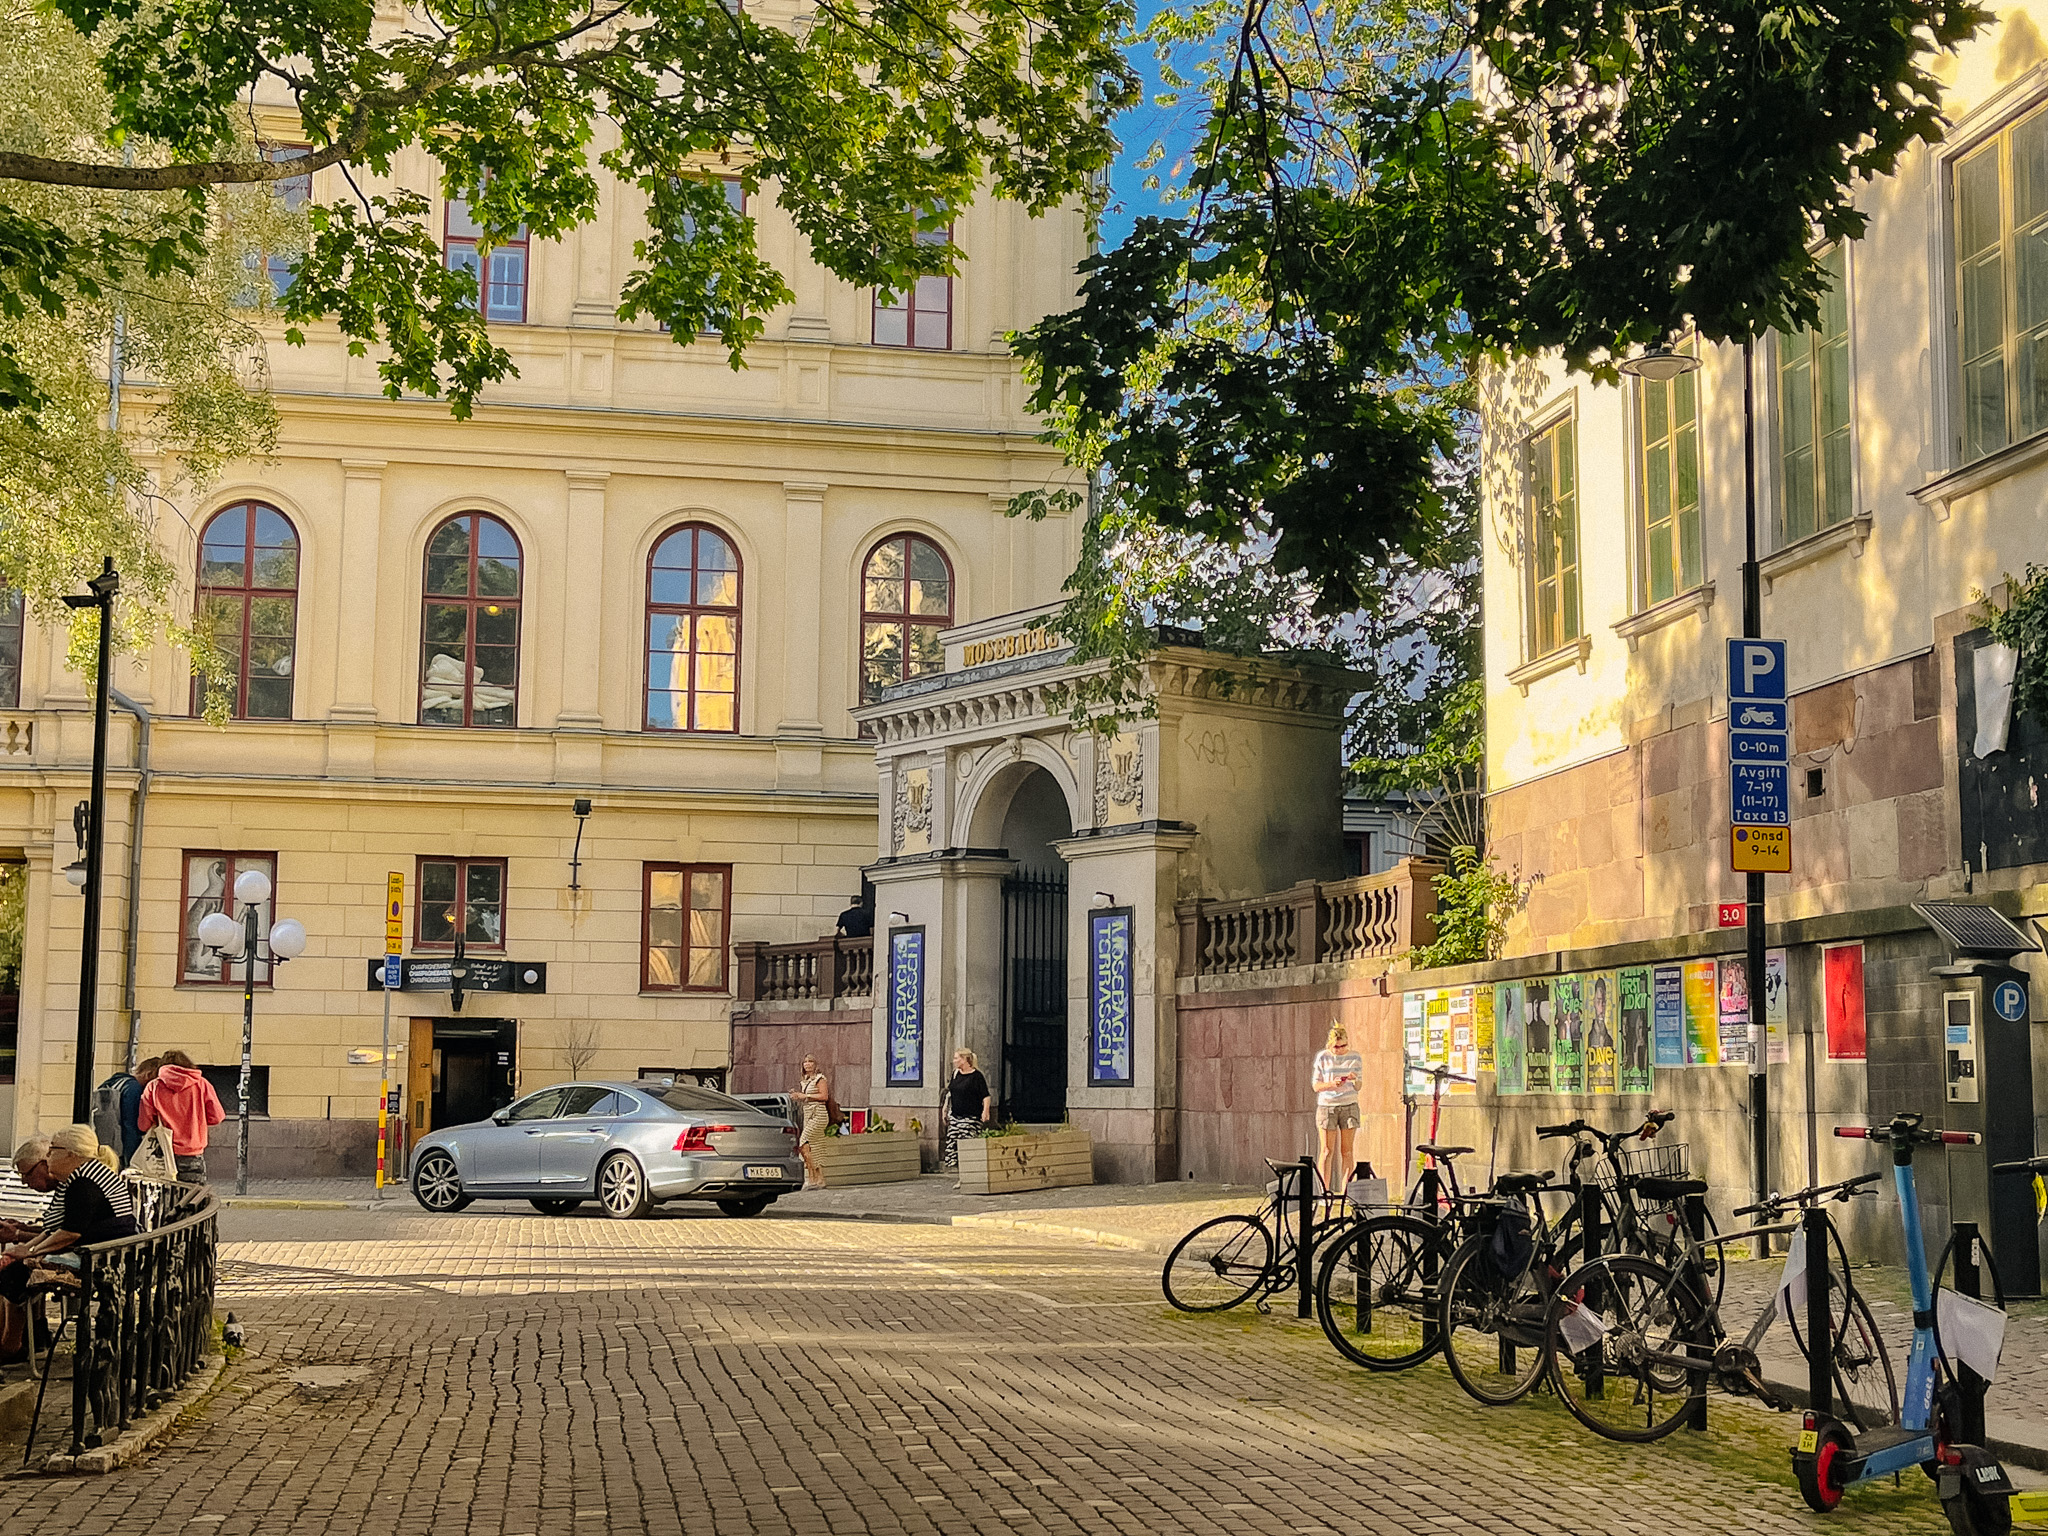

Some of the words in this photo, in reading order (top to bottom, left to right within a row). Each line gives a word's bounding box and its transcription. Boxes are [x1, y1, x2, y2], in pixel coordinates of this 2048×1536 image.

[1743, 645, 1776, 693] P
[1739, 767, 1781, 781] Avgift
[1746, 781, 1774, 792] 7-19
[1741, 794, 1779, 808] (11-17)
[1735, 809, 1769, 822] Taxa
[1773, 811, 1787, 822] 13
[1752, 830, 1783, 841] Onsd
[1751, 845, 1780, 856] 9-14
[1098, 922, 1112, 1066] TERRASSEN
[2003, 988, 2020, 1014] P
